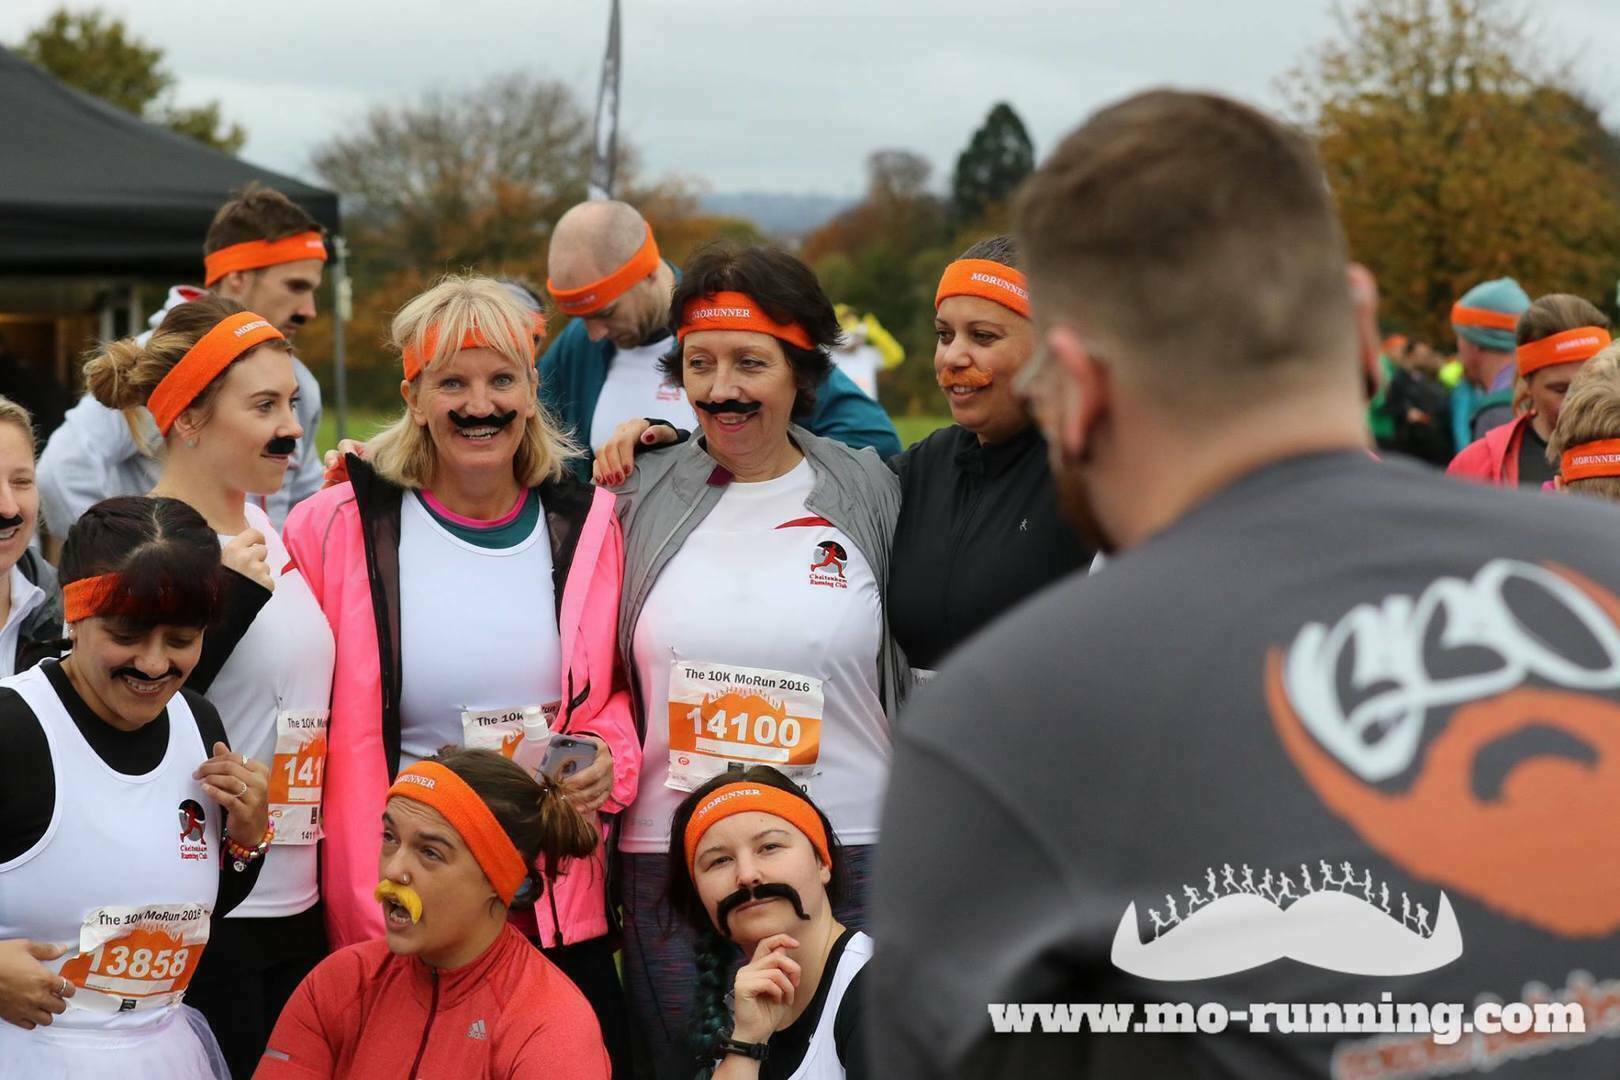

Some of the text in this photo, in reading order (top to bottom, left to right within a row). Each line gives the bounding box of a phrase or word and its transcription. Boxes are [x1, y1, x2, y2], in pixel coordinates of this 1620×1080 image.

[685, 668, 810, 692] The 10K MoRun 2016
[287, 718, 300, 728] The
[301, 718, 316, 728] 10K
[478, 716, 498, 727] The
[687, 707, 801, 748] 14100
[284, 755, 325, 786] 141
[698, 789, 761, 817] MORUNNER
[99, 911, 121, 925] The
[144, 910, 180, 922] MoRun
[87, 943, 189, 979] 13858
